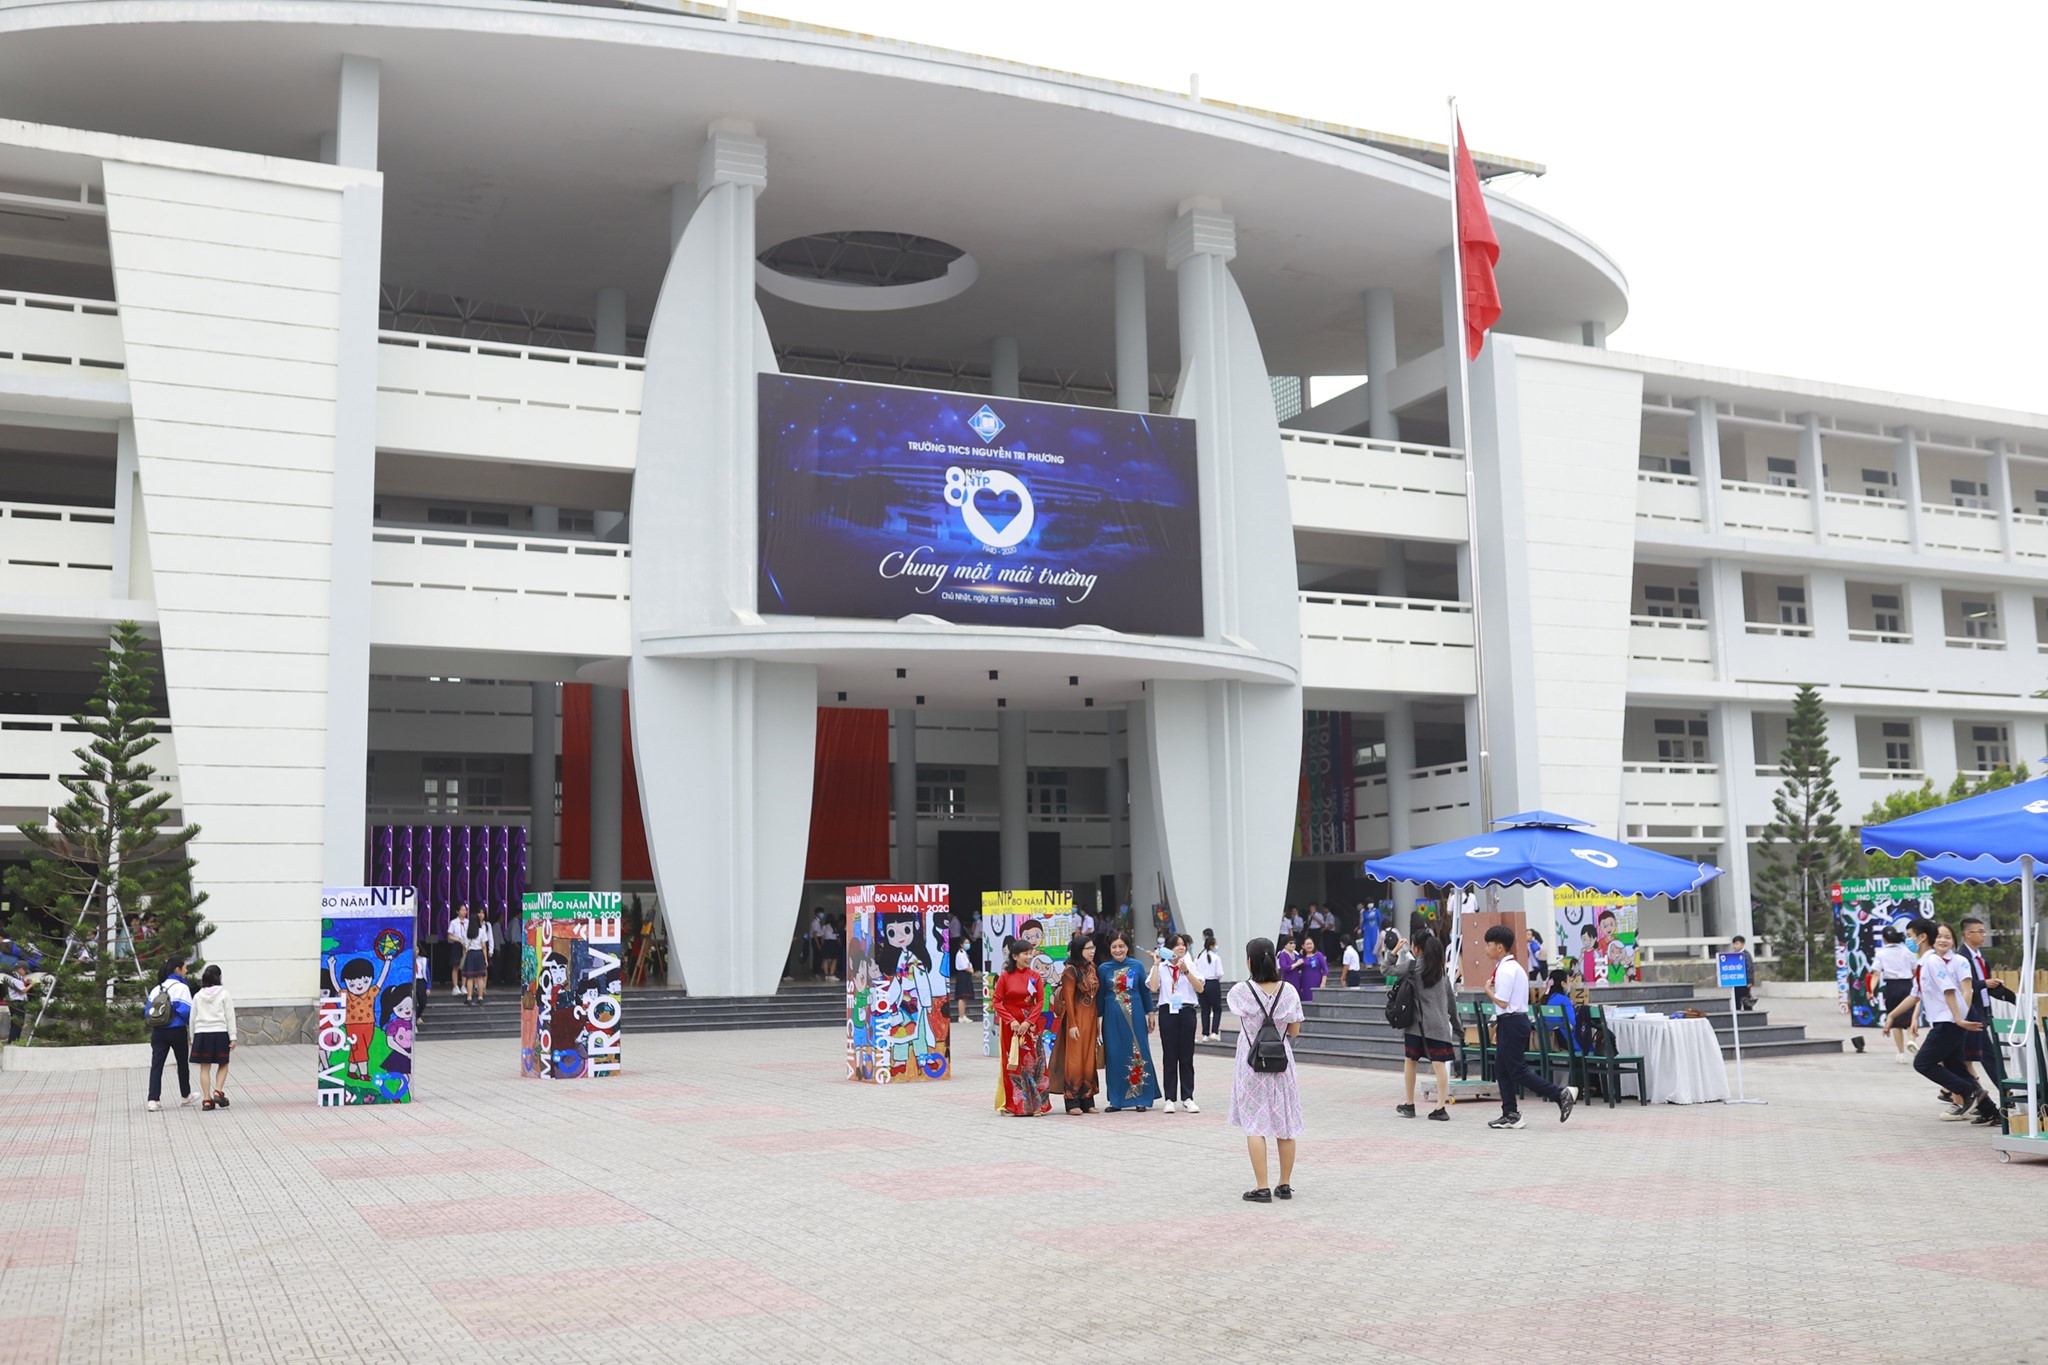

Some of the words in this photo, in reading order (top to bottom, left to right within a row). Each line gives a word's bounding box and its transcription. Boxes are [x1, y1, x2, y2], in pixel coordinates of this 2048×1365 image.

[908, 441, 946, 453] TRƯỜNG
[947, 445, 970, 455] THCS
[972, 446, 1011, 459] NGUYỄN
[1013, 452, 1026, 461] TRI
[1027, 453, 1065, 464] PHƯƠNG
[966, 476, 990, 488] NTP
[879, 545, 949, 594] Chung
[953, 562, 993, 583] một
[997, 563, 1035, 583] mái
[1038, 567, 1098, 604] trường
[942, 592, 954, 601] Chủ
[973, 595, 989, 604] ngày
[989, 594, 999, 603] 28
[1000, 594, 1018, 605] tháng
[1024, 597, 1038, 605] năm
[1039, 598, 1056, 606] 2021
[861, 885, 875, 903] NTP
[889, 892, 913, 903] NĂM
[914, 884, 949, 903] NTP
[1865, 878, 1890, 893] NTP
[340, 896, 368, 907] NĂM
[371, 887, 415, 906] NTP
[537, 892, 552, 910] NTP
[565, 899, 588, 909] NĂM
[588, 892, 622, 910] NTP
[997, 890, 1012, 906] NTP
[1024, 897, 1043, 905] NĂM
[1044, 890, 1073, 906] NTP
[573, 911, 592, 919] 1940
[600, 911, 622, 919] 2020
[897, 905, 919, 913] 1940
[846, 1019, 855, 1080] CHIA
